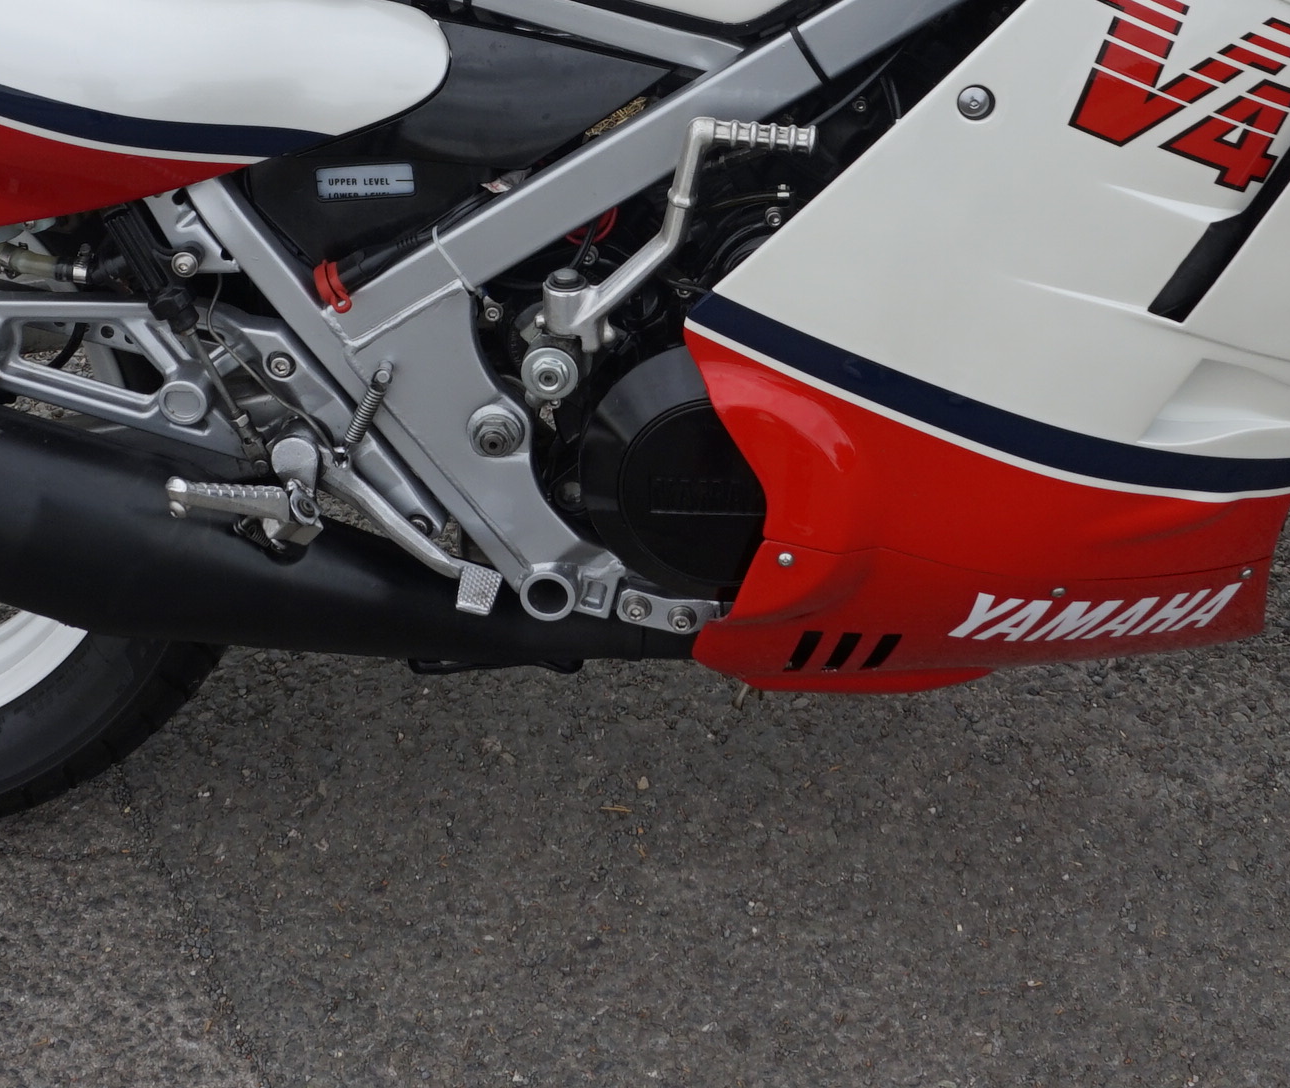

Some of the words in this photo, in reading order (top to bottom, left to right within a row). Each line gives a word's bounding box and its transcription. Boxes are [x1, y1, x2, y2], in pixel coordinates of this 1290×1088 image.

[328, 177, 358, 186] UPPER
[363, 177, 391, 186] LEVEL
[947, 582, 1243, 642] YAMAHA
